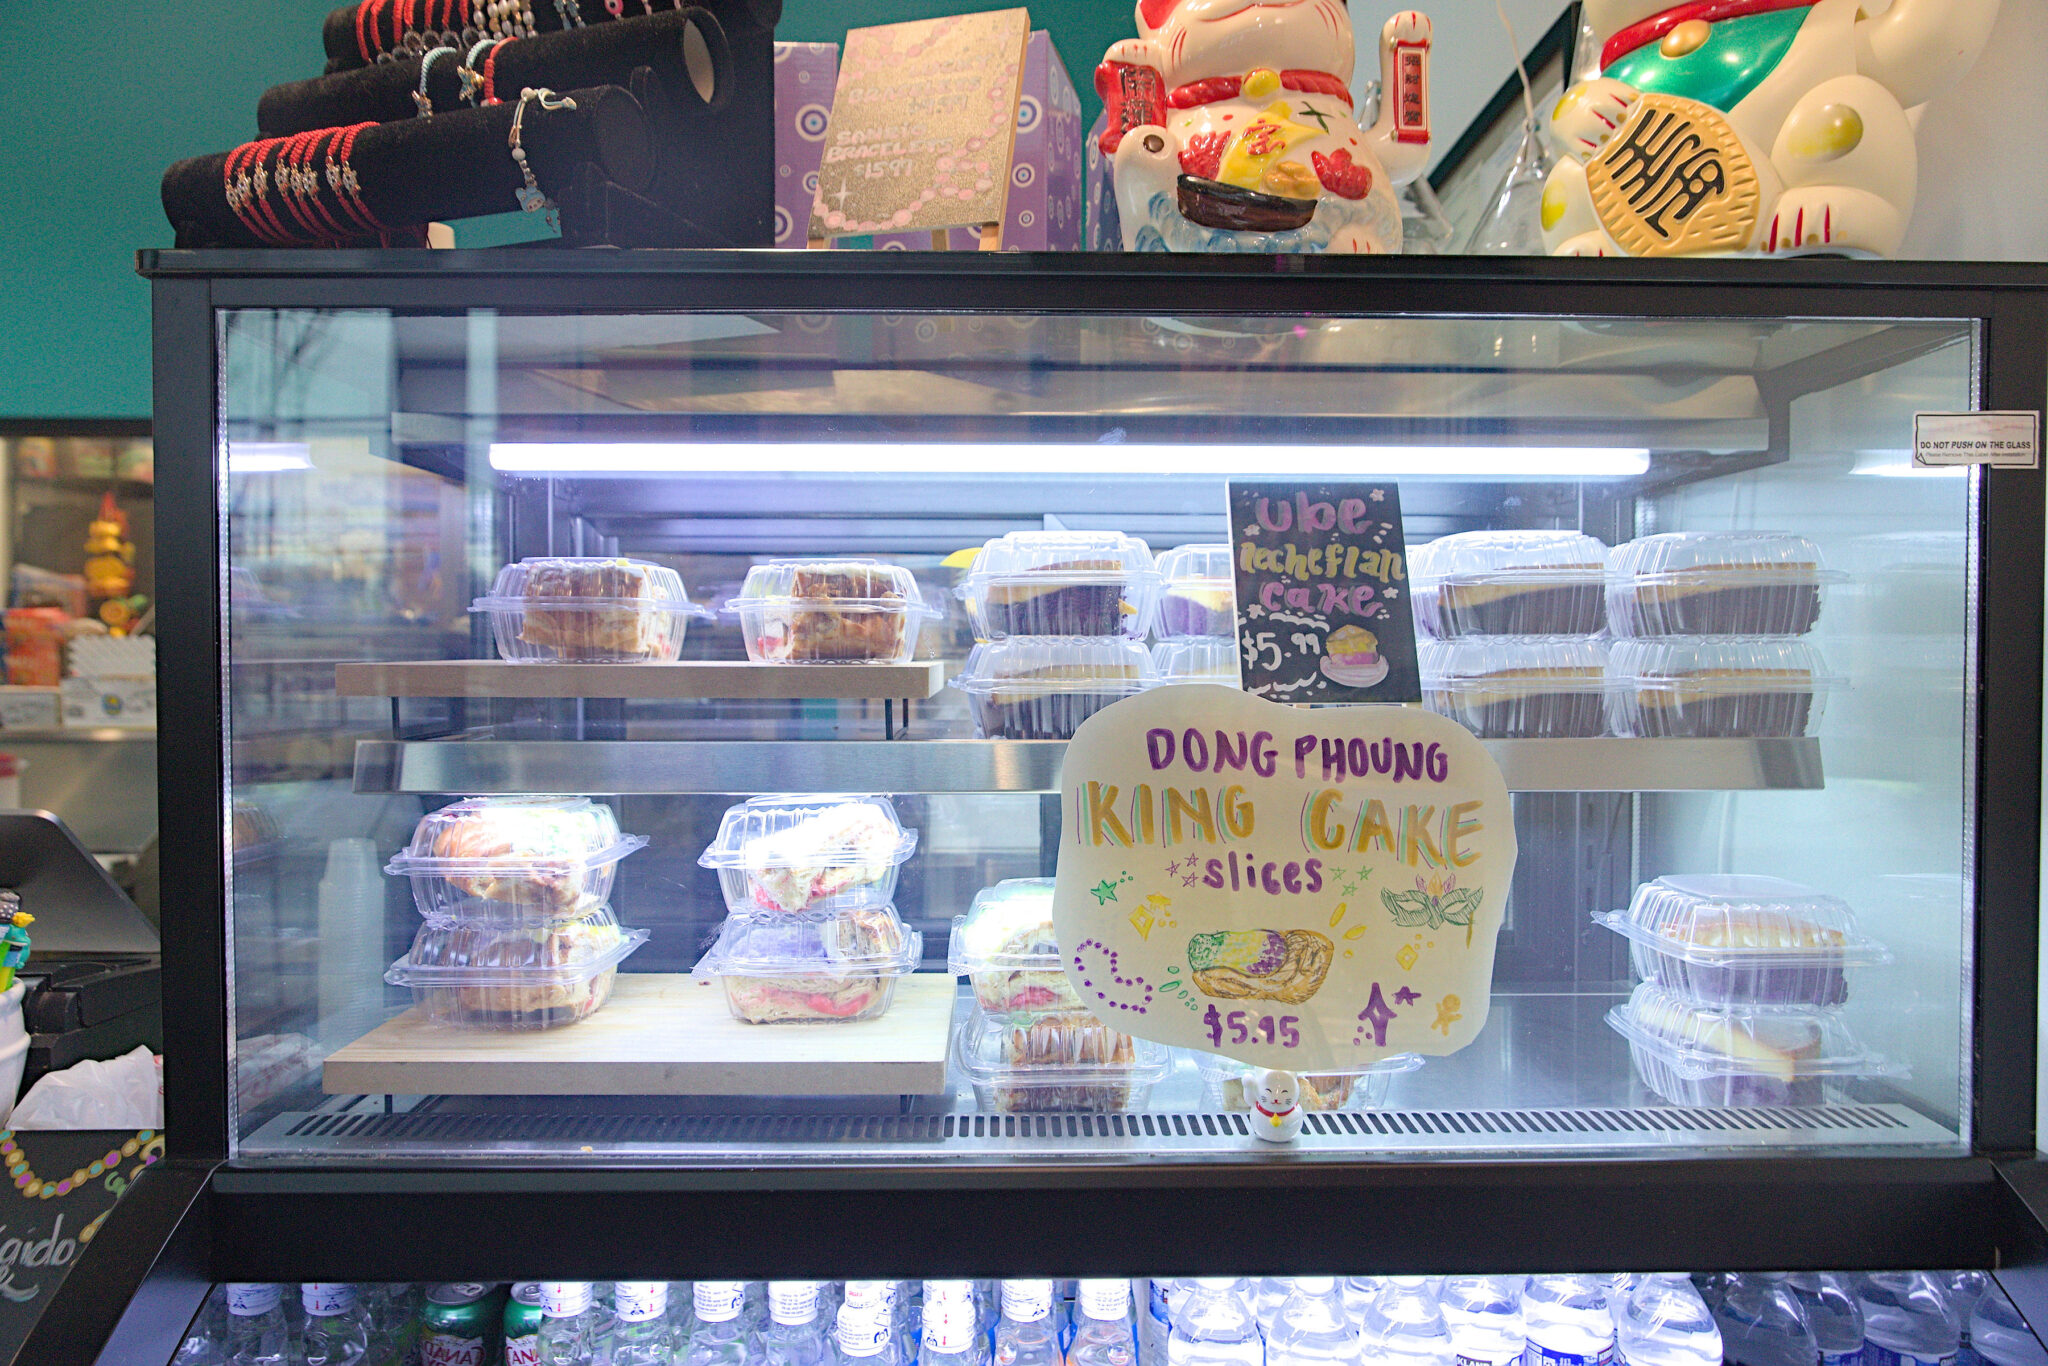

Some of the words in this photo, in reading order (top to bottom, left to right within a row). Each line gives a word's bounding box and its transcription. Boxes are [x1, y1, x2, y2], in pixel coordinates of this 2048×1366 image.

[848, 76, 982, 104] BRACELETS
[826, 138, 954, 163] BRACELETS
[1920, 441, 1931, 449] DO
[1933, 441, 1949, 449] NOT
[1951, 441, 1973, 449] PUSH
[1975, 441, 1987, 449] ON
[1990, 441, 2004, 449] THE
[2006, 441, 2031, 449] GLASS
[1241, 630, 1321, 671] $5.99
[1146, 728, 1278, 778] DONG
[1294, 734, 1449, 783] PHOUNG
[1077, 781, 1256, 848] KING
[1300, 788, 1485, 869] CAKE
[1202, 851, 1322, 895] slices
[1203, 1003, 1300, 1048] $5.95
[0, 1213, 77, 1267] aido
